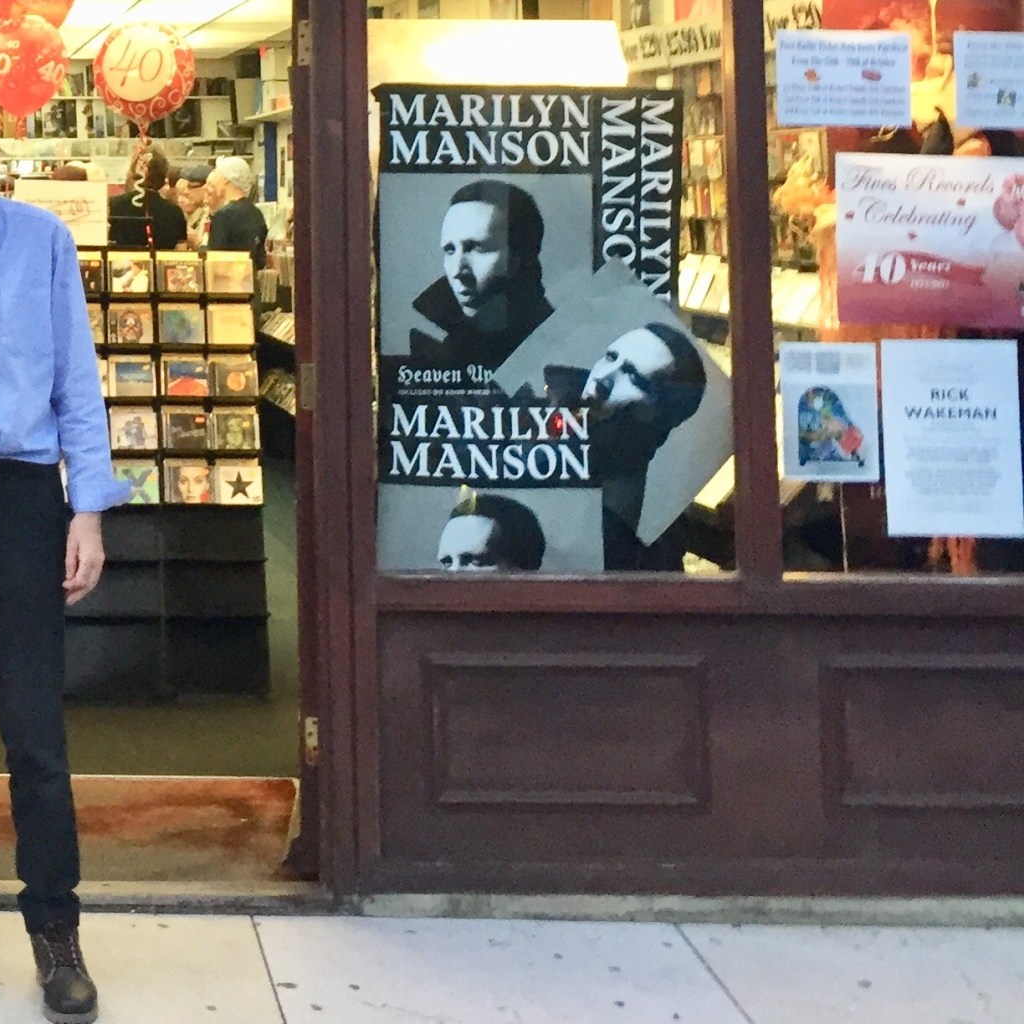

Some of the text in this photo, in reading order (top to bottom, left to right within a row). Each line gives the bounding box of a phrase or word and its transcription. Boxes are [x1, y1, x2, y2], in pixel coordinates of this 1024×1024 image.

[38, 60, 66, 83] 40
[108, 38, 164, 88] 40
[389, 94, 591, 128] MARILYN
[389, 130, 591, 166] MANSON
[601, 96, 637, 275] MANSO
[841, 164, 994, 194] Fives Records
[640, 97, 675, 303] MARILYN
[858, 195, 978, 235] Celebrating
[853, 250, 907, 285] 40
[910, 258, 953, 273] Years
[397, 364, 462, 386] Heaven
[930, 386, 970, 402] RICK
[389, 403, 591, 441] MARILYN
[904, 405, 998, 422] WAKEMAN
[389, 440, 591, 482] MANSON
